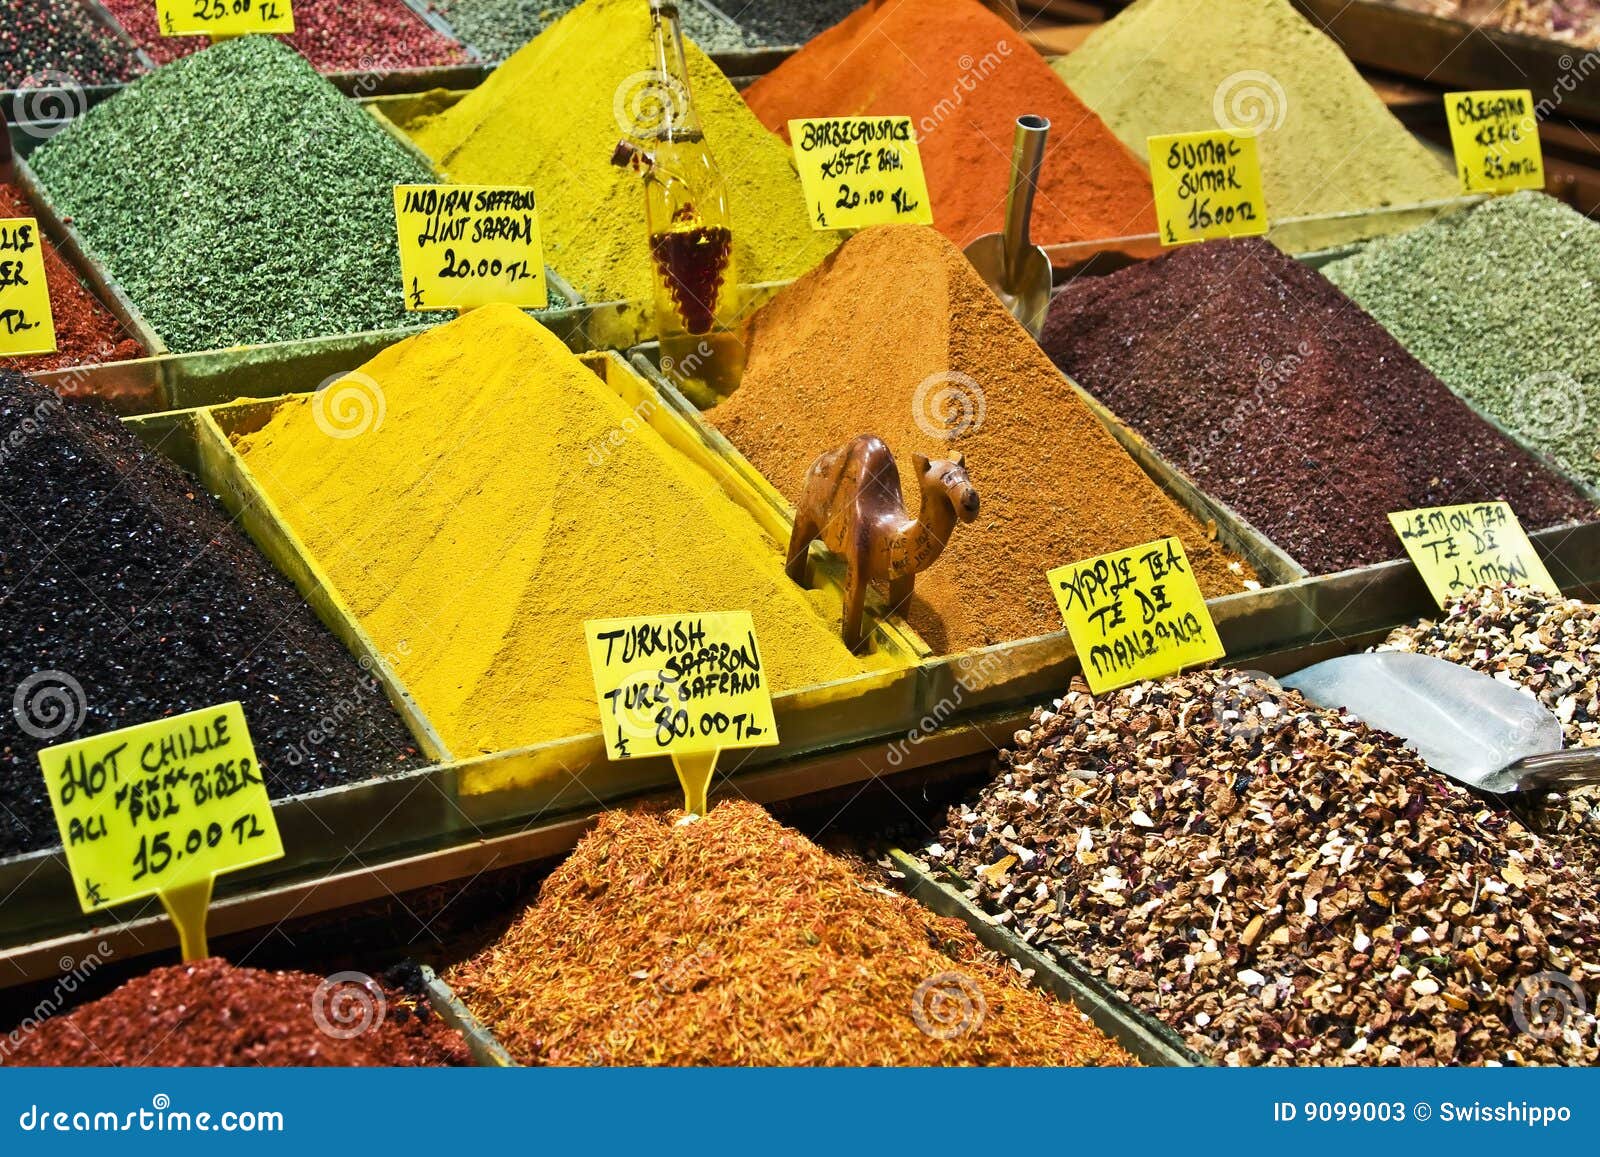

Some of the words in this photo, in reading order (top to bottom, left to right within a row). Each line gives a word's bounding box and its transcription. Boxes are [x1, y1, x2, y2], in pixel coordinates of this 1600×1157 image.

[1168, 139, 1241, 169] SUMAC
[836, 184, 884, 209] 20.00
[1178, 165, 1242, 199] SUMAK
[403, 189, 473, 216] INDIAN
[475, 190, 535, 212] SAFFRON
[438, 248, 503, 278] 20.00
[1402, 510, 1474, 539] LEMON
[1468, 529, 1499, 555] DE
[1060, 559, 1137, 611] APPLE
[1140, 541, 1184, 582] TEA
[1134, 585, 1172, 624] DE
[597, 618, 706, 666] TURKISH
[658, 631, 760, 683] SAFFRON
[1090, 612, 1206, 677] MANZANA
[678, 672, 760, 701] SAFRANI
[655, 705, 730, 746] 80.00
[60, 742, 128, 806] HOT
[133, 822, 222, 881] 15.00
[231, 814, 265, 844] TL
